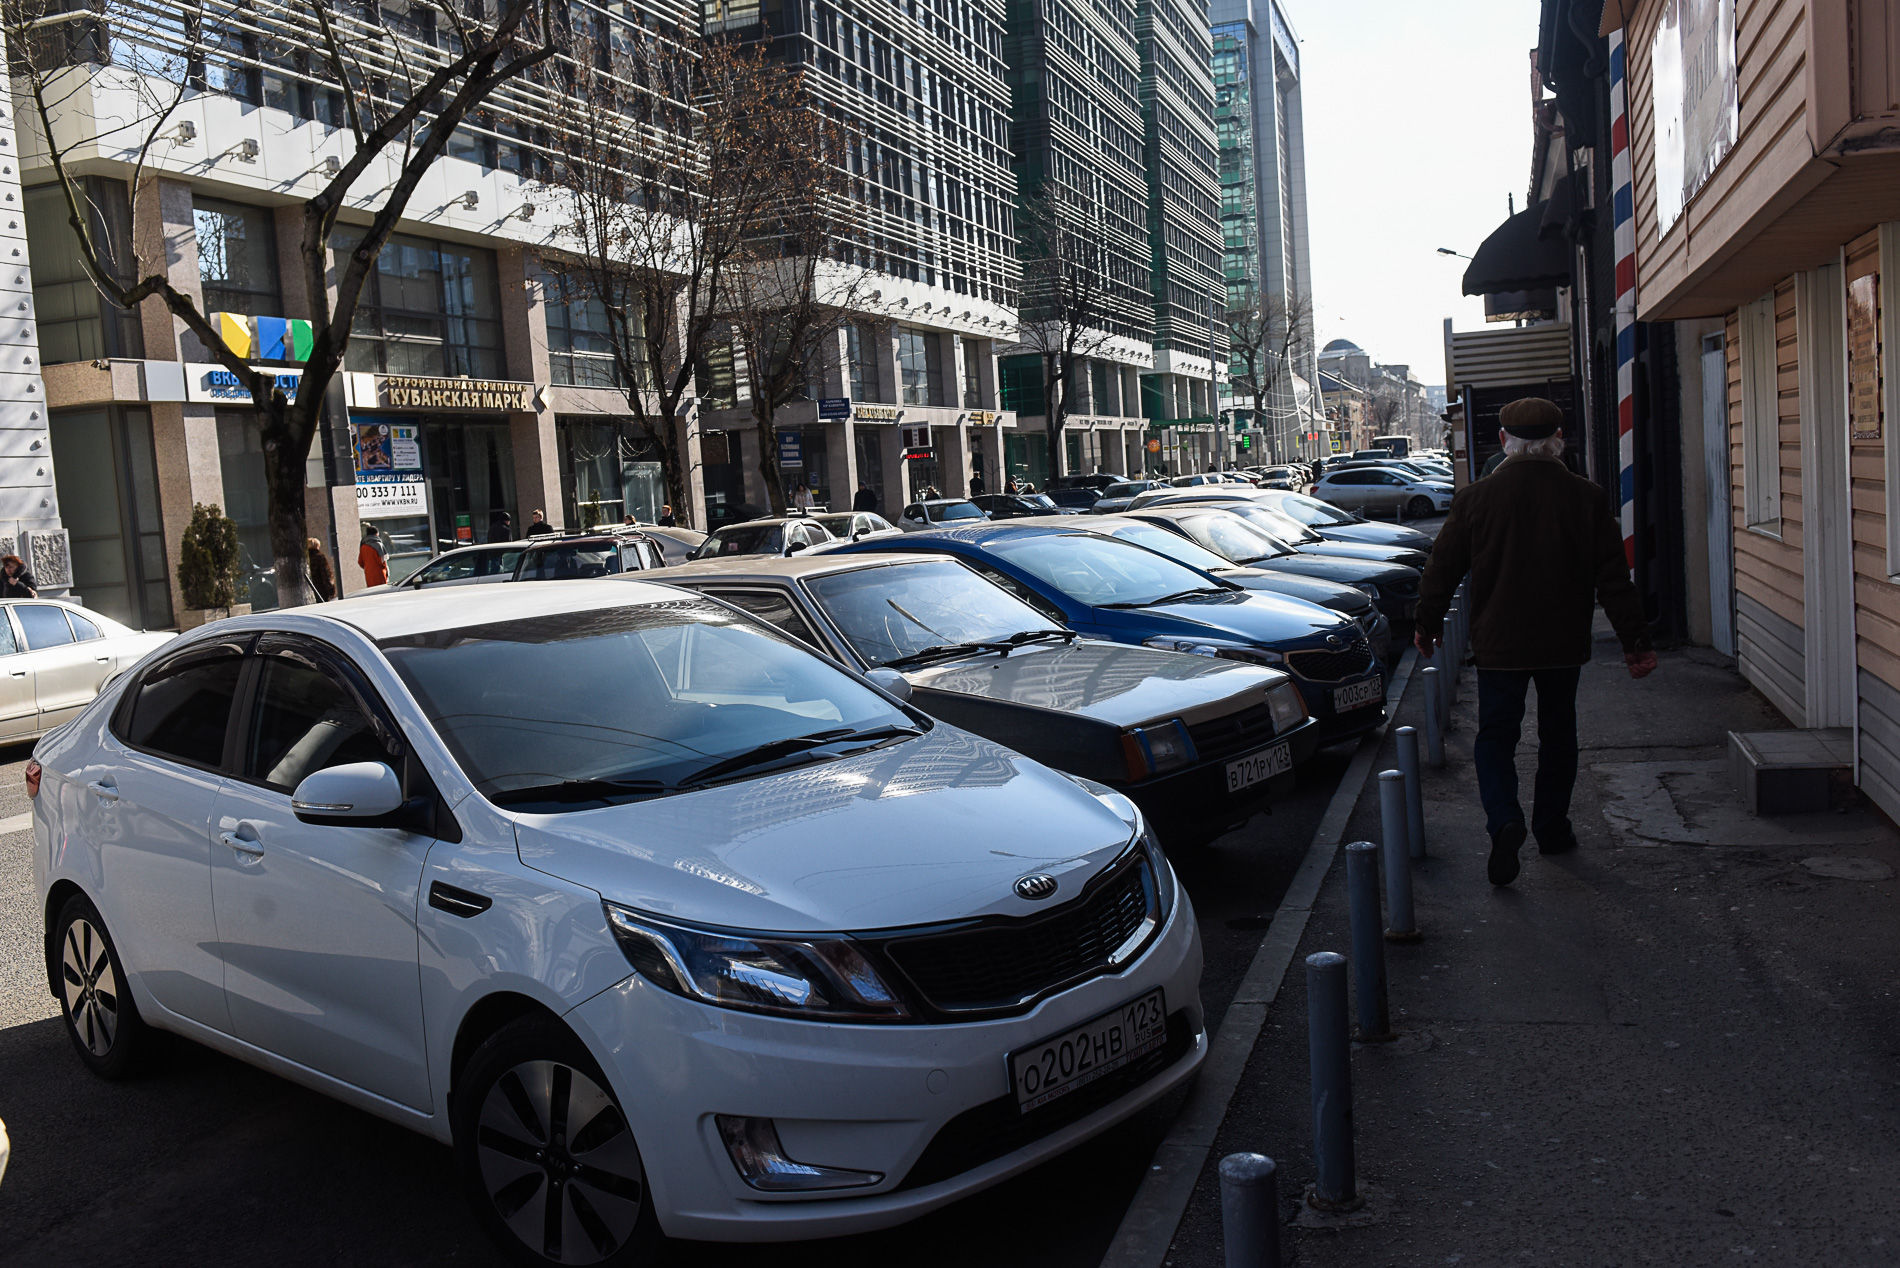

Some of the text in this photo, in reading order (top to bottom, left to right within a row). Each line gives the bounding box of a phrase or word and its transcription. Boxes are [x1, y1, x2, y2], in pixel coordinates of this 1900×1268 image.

[388, 377, 474, 391] СТРОИТЕЛЬНАЯ
[390, 388, 529, 409] КУБАНСКАЯ МАРКА
[371, 486, 389, 498] 333
[391, 486, 397, 497] 7
[401, 485, 417, 497] 111
[1337, 677, 1380, 706] У003СР 123
[1231, 745, 1290, 788] В721РУ 123
[1020, 876, 1054, 895] KIA
[1024, 1026, 1123, 1095] О202НВ
[1127, 995, 1161, 1033] 123
[1134, 1028, 1151, 1045] RUS
